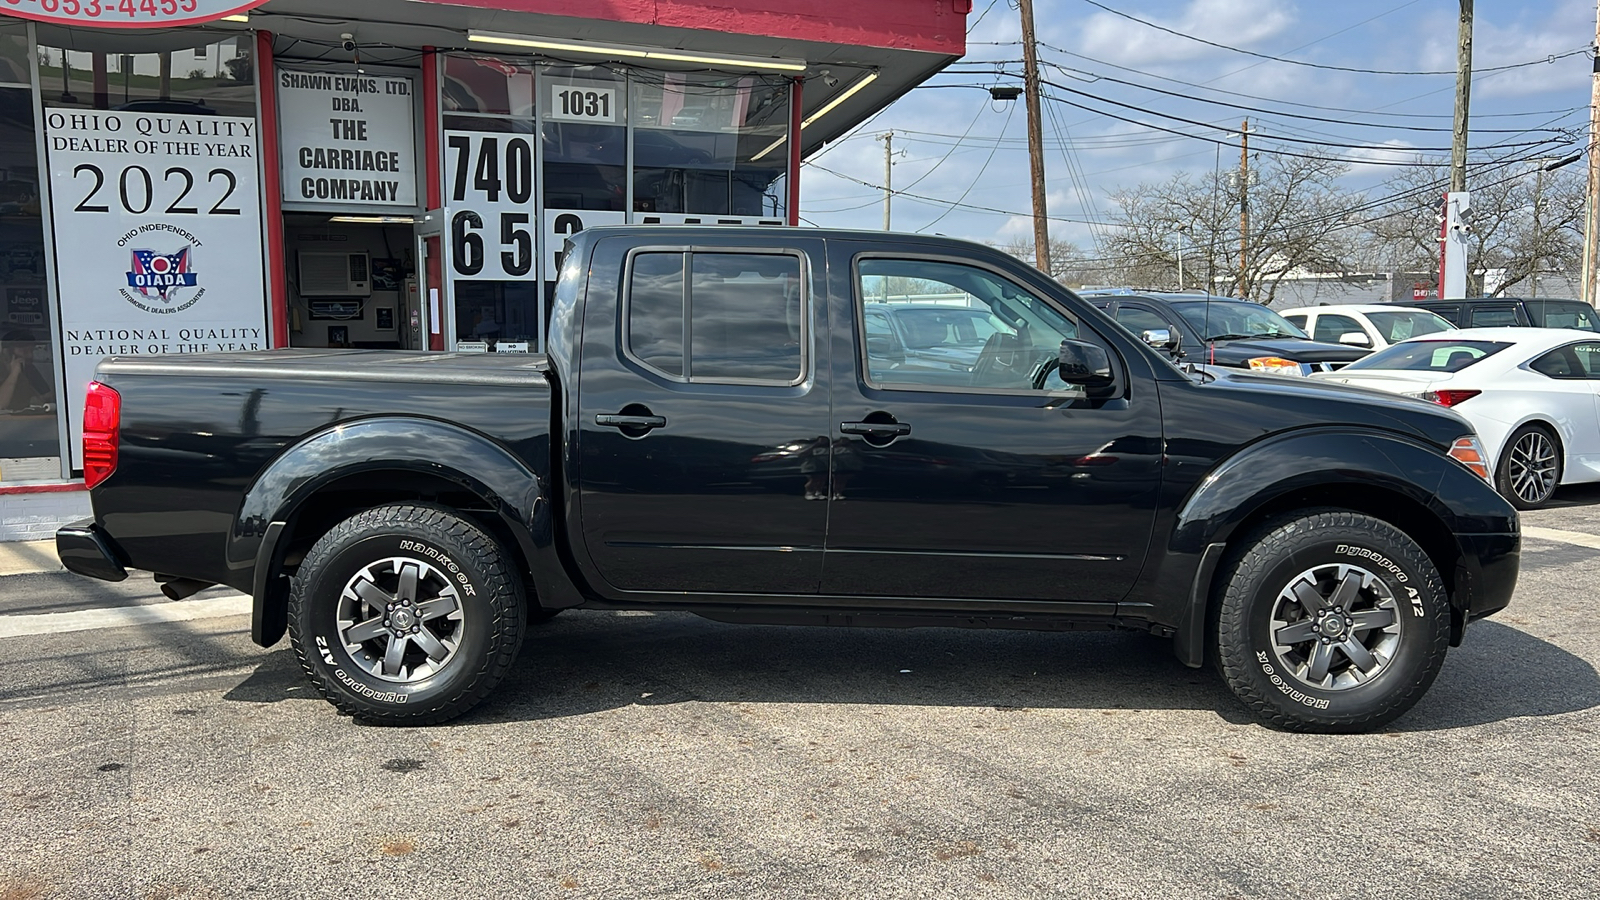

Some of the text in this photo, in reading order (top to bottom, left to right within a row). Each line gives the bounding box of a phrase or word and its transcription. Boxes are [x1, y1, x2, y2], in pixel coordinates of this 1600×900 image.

[281, 73, 332, 90] SHAWN
[385, 80, 411, 96] LTD.
[332, 97, 363, 113] DBA.
[558, 89, 610, 117] 1031
[48, 113, 254, 138] OHIO QUALITY
[330, 118, 368, 141] THE
[53, 136, 252, 158] DEALER OF THE YEAR
[299, 147, 399, 172] CARRIAGE
[448, 135, 533, 204] 740
[73, 163, 241, 215] 2022
[301, 177, 399, 201] COMPANY
[117, 223, 203, 248] OHIO INDEPENDENT
[135, 274, 186, 286] OIADA
[119, 287, 150, 313] AUTOMOBILE
[177, 287, 206, 312] ASSOCIATION
[67, 328, 261, 341] NATIONAL QUALITY
[70, 343, 259, 355] DEALER OF THE YEAR
[1404, 585, 1425, 618] AT2
[315, 635, 339, 667] AT2
